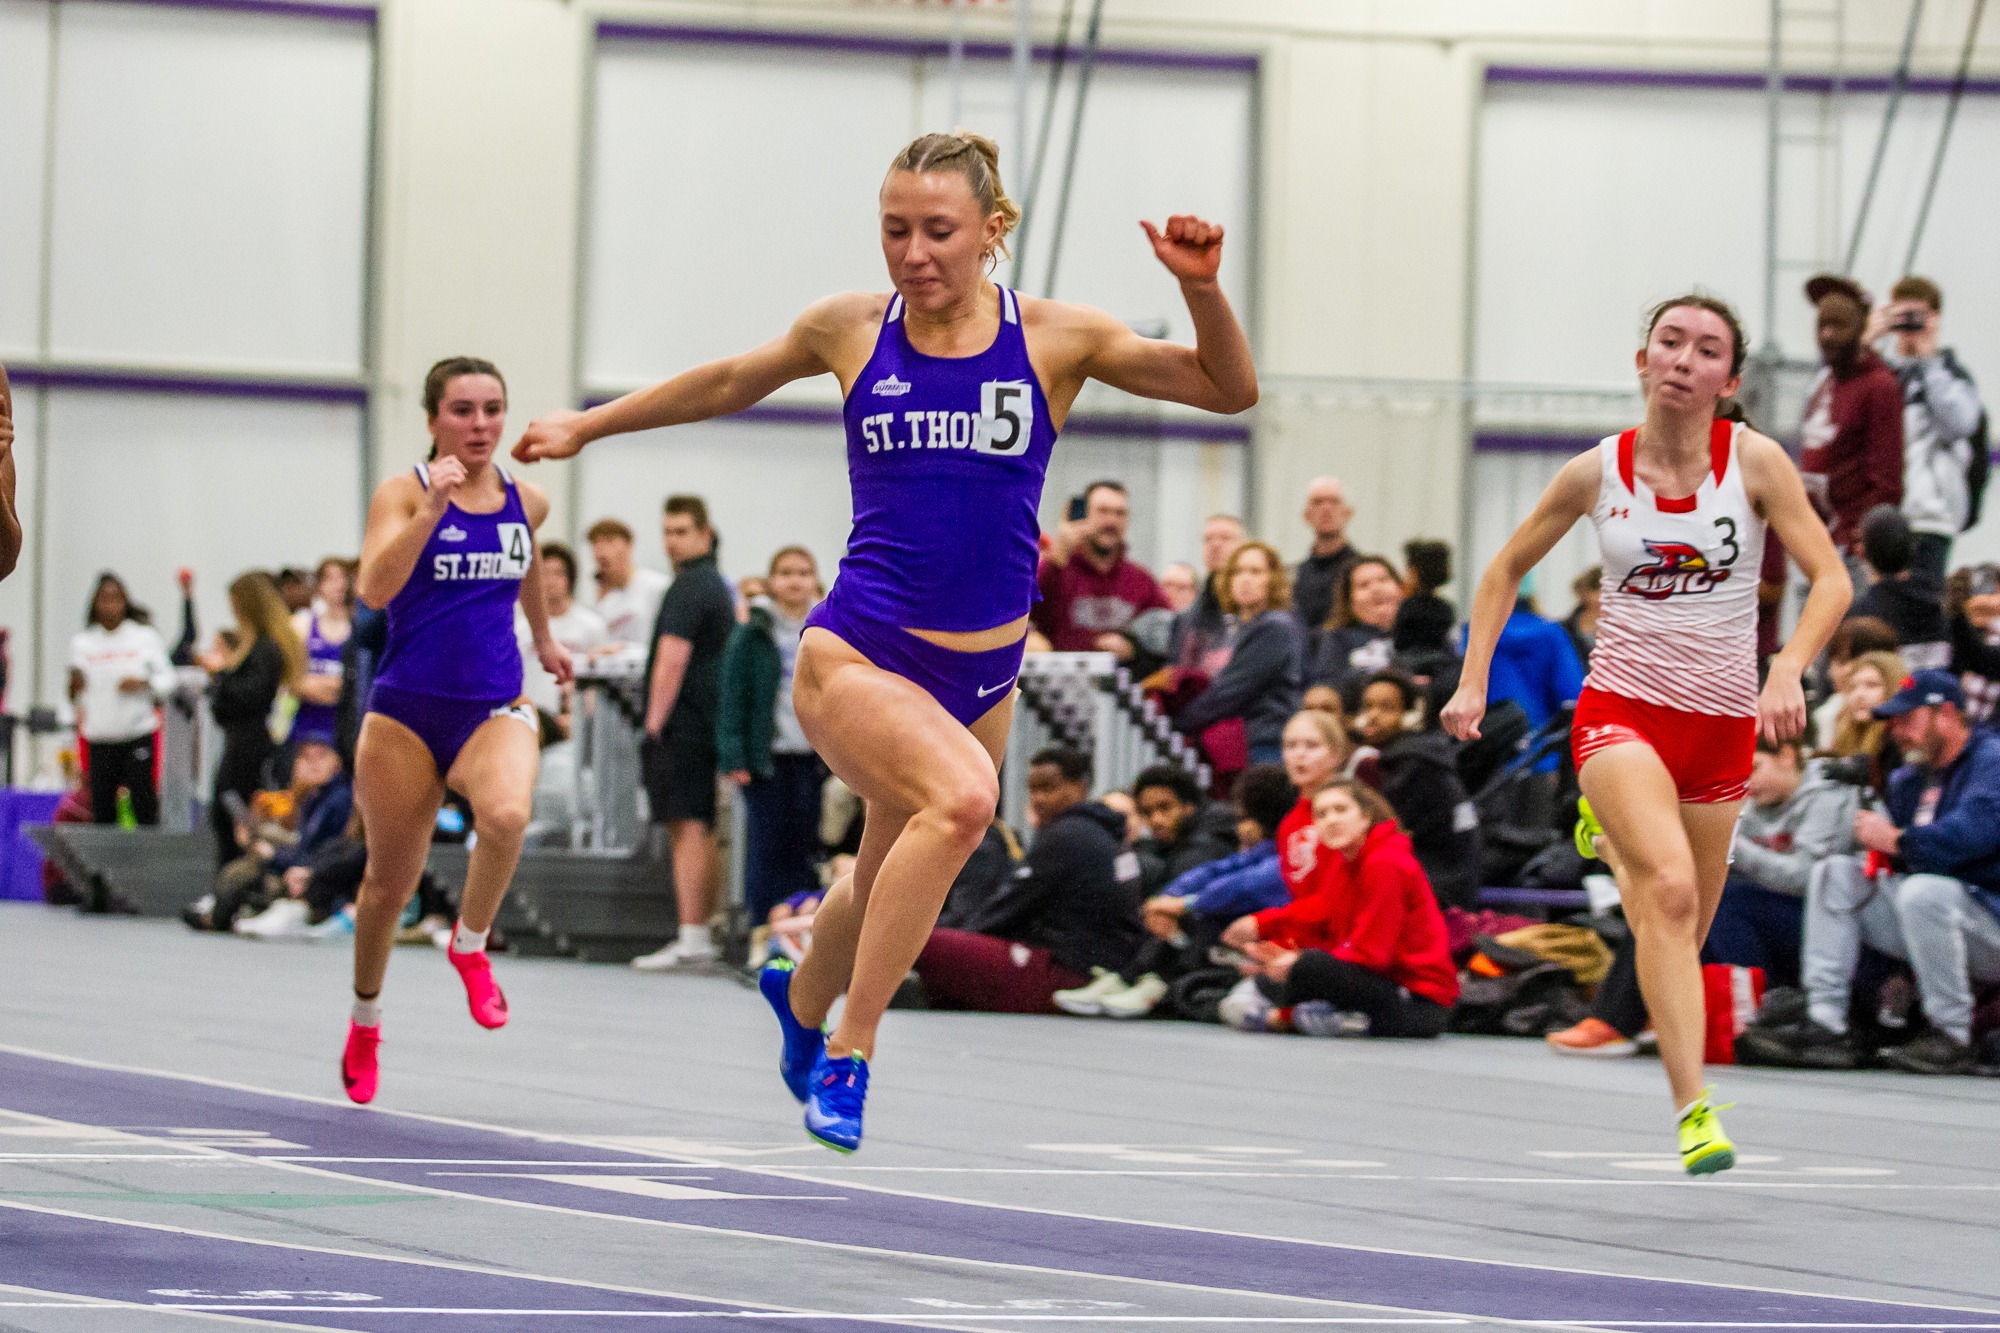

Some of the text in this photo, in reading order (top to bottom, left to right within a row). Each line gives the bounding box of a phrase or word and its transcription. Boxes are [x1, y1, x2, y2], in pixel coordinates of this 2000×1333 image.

[990, 387, 1021, 451] 5
[510, 528, 525, 570] 4
[1713, 516, 1740, 567] 3
[434, 552, 506, 580] ST.THO
